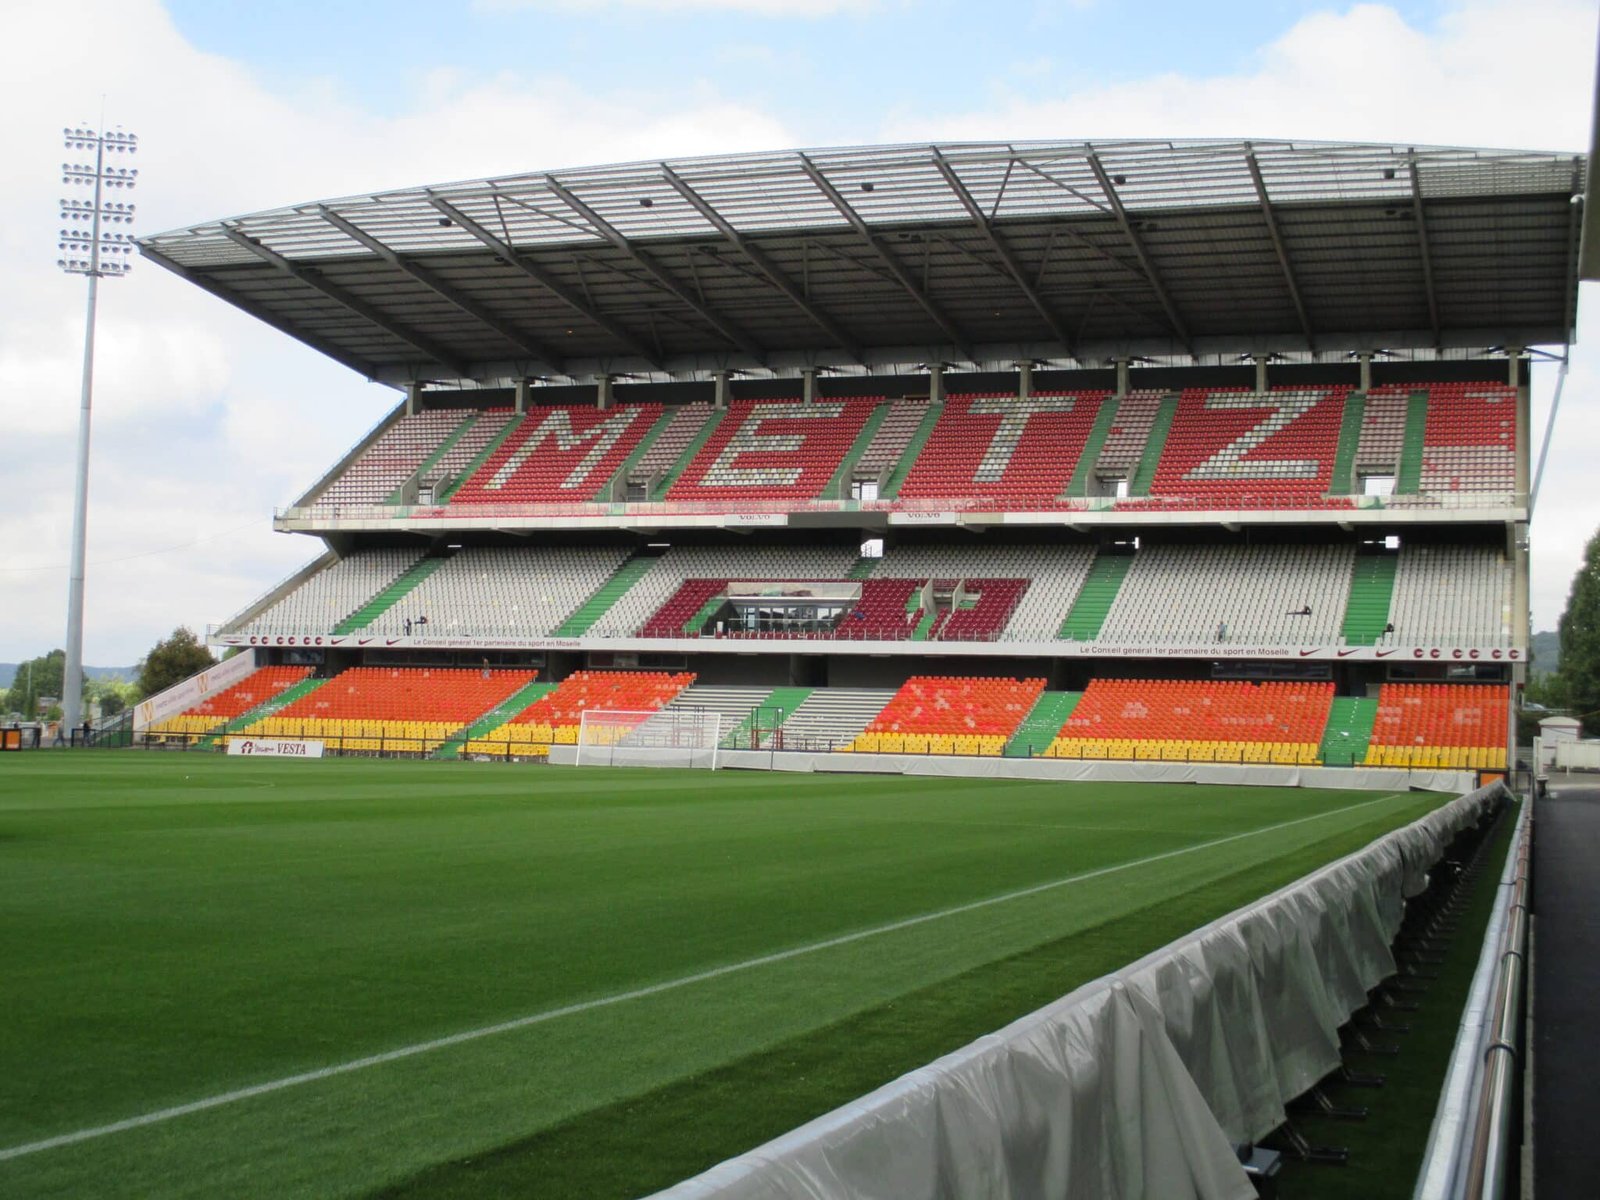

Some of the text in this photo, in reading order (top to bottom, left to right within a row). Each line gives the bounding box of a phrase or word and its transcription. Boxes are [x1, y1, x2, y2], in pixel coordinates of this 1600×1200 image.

[482, 389, 1323, 489] METZ
[1168, 647, 1208, 656] partenaire
[1223, 648, 1244, 657] sport
[277, 743, 306, 755] VESTA
